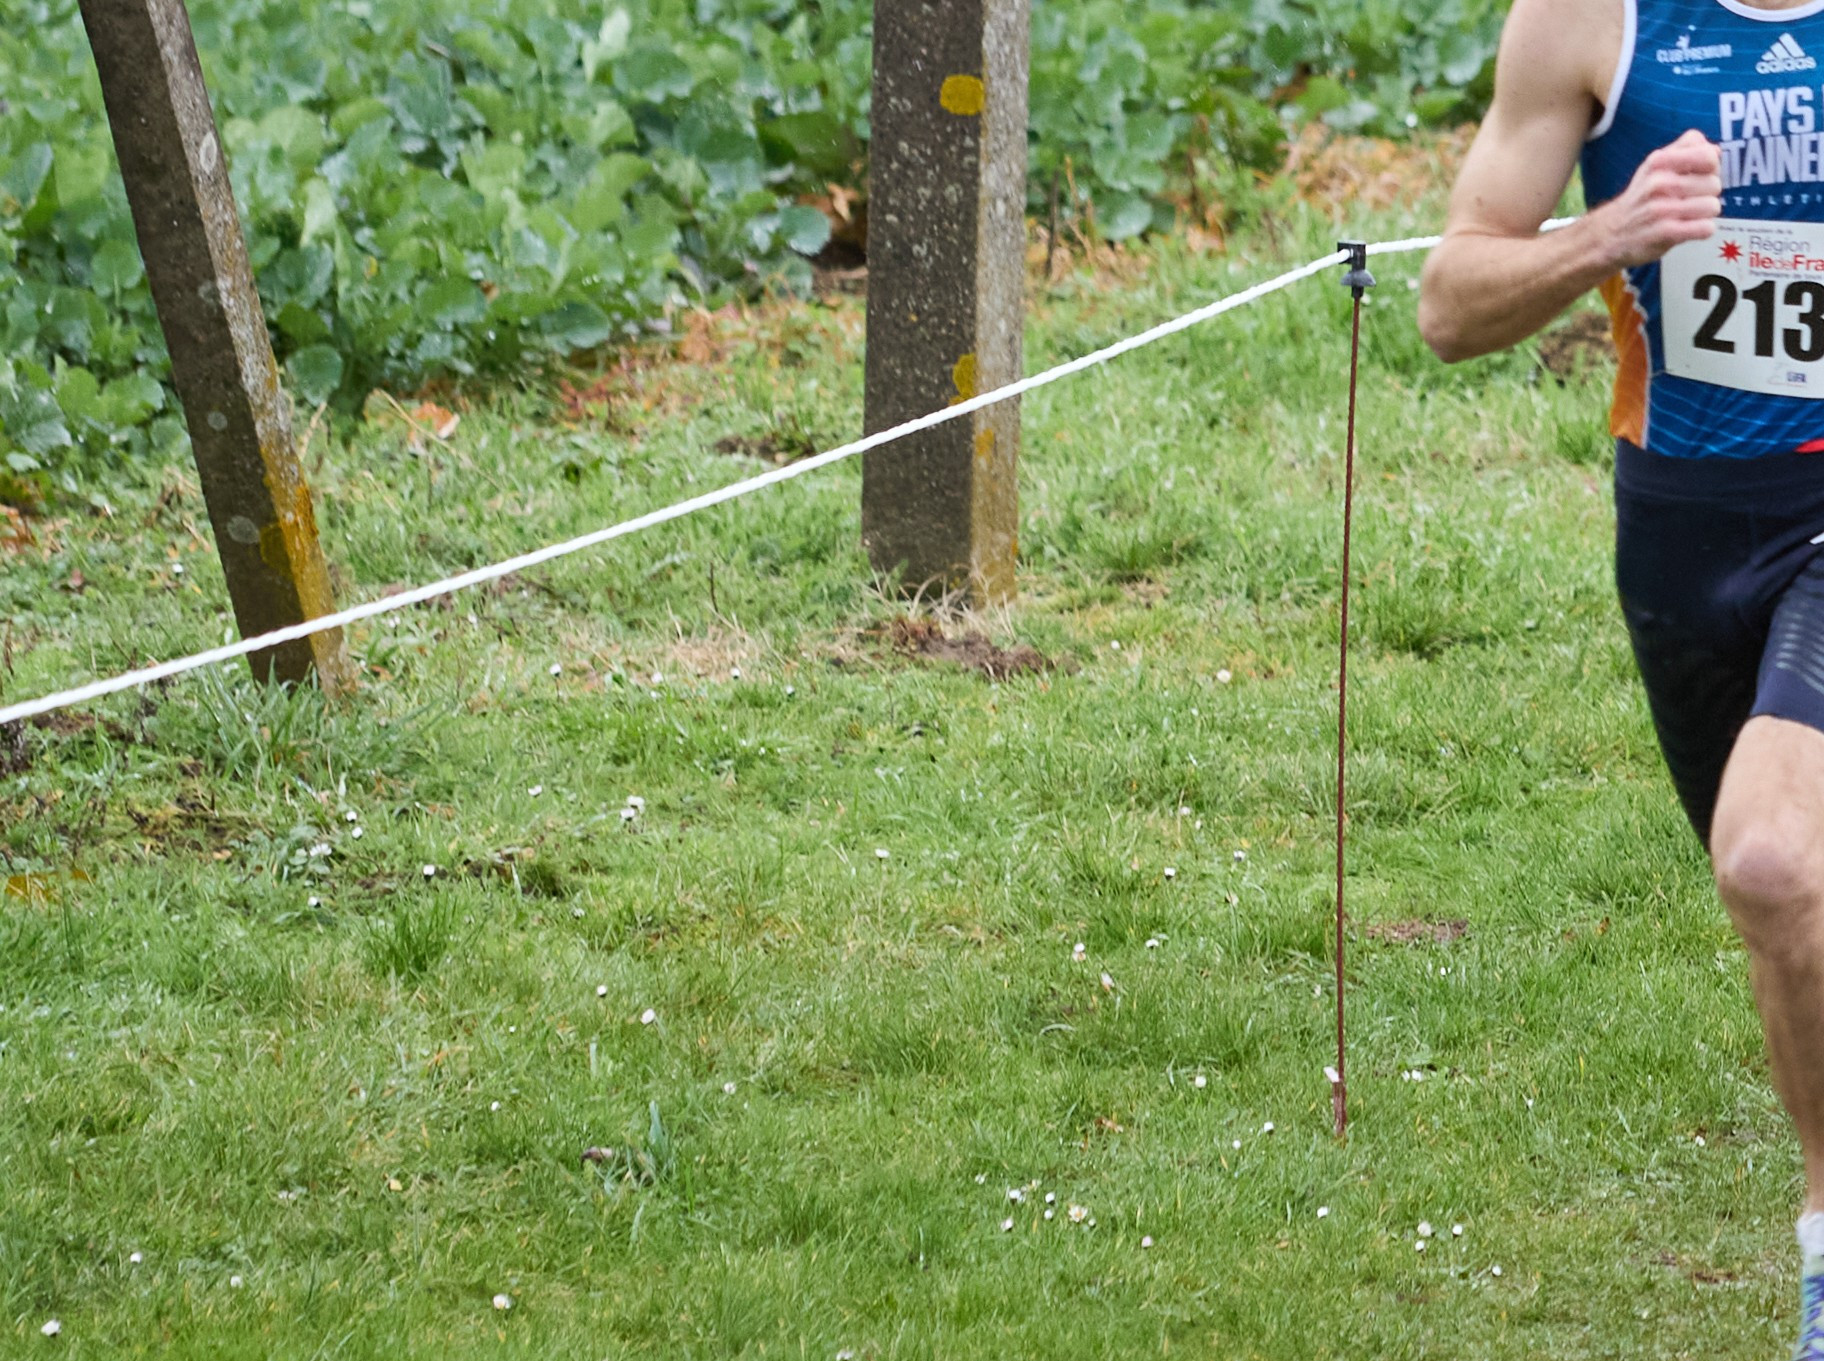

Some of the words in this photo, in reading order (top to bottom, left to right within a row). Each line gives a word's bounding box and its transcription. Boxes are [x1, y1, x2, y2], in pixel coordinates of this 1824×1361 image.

[1755, 56, 1817, 74] adidas
[1719, 86, 1814, 140] PAYS
[1749, 235, 1811, 255] Région
